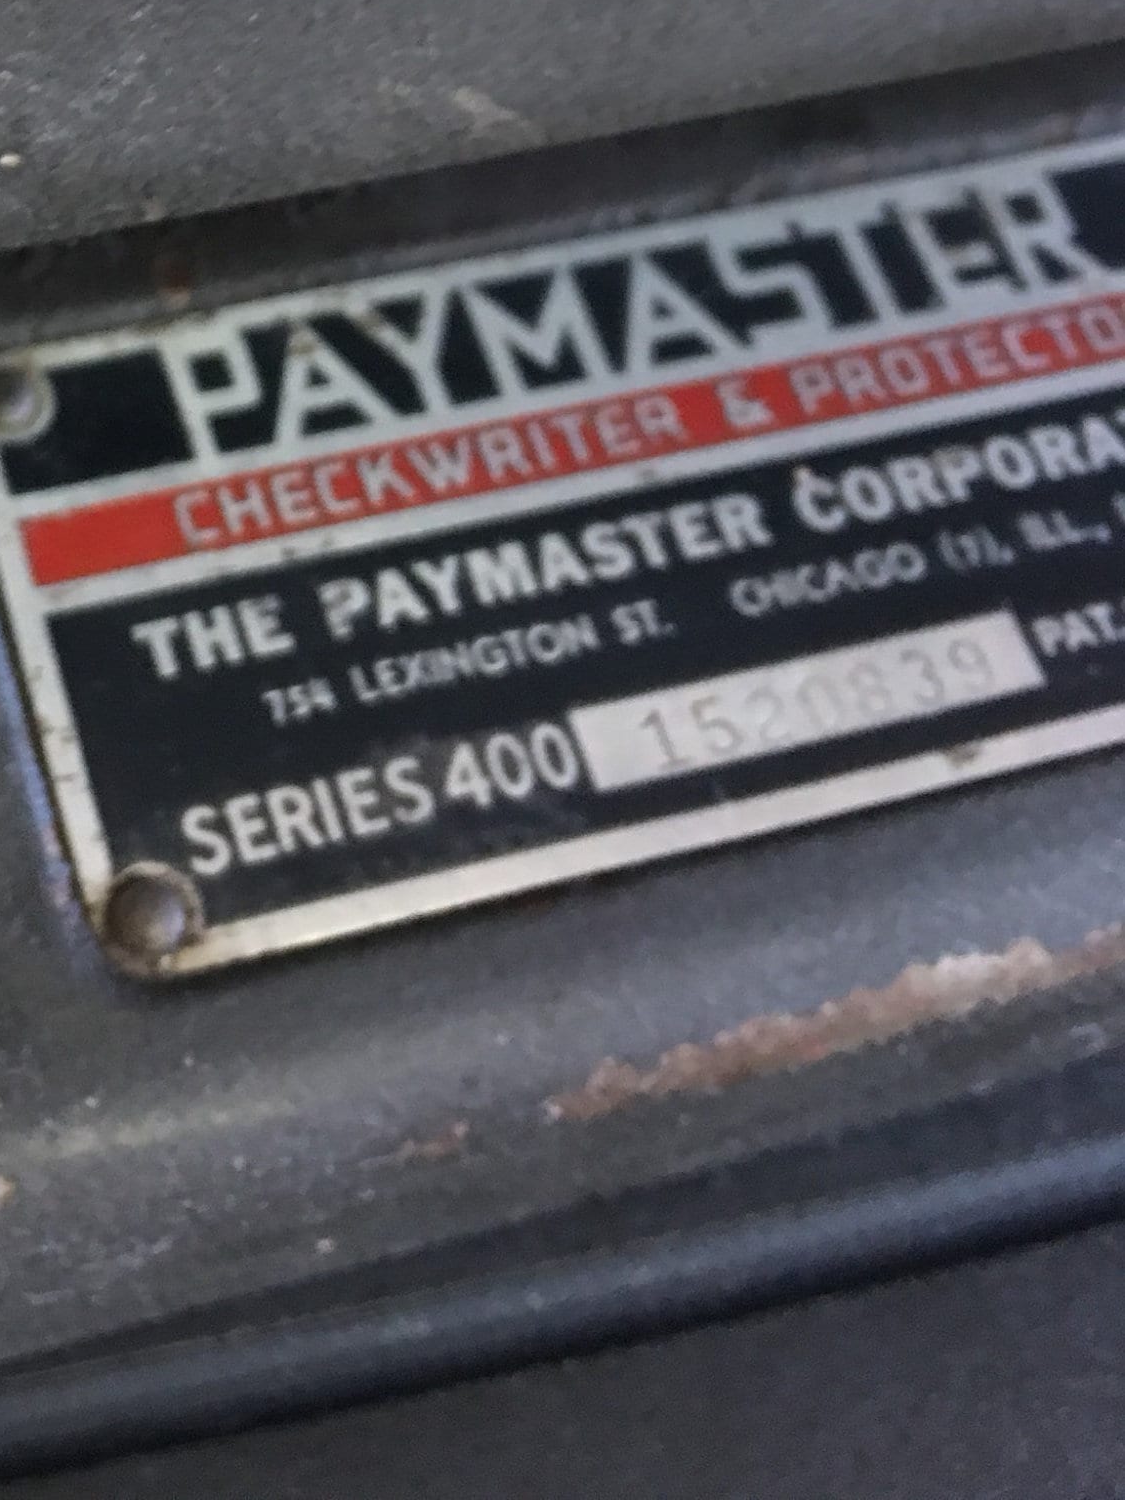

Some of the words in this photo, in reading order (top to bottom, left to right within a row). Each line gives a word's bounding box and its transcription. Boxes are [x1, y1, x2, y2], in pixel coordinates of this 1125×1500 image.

[159, 172, 1111, 465] PAYMASTER
[175, 393, 687, 544] CHECKWRITER
[715, 373, 774, 430] &
[787, 300, 1125, 414] PROTECTO
[131, 593, 297, 681] THE
[317, 492, 775, 640] PAYMASTER
[790, 408, 1125, 533] CORPORA
[347, 613, 602, 704] LEXINGTON
[611, 598, 675, 646] ST.
[729, 540, 928, 618] CHICAGO
[180, 755, 435, 876] SERIES
[444, 721, 579, 808] 400
[637, 637, 995, 770] 1520839
